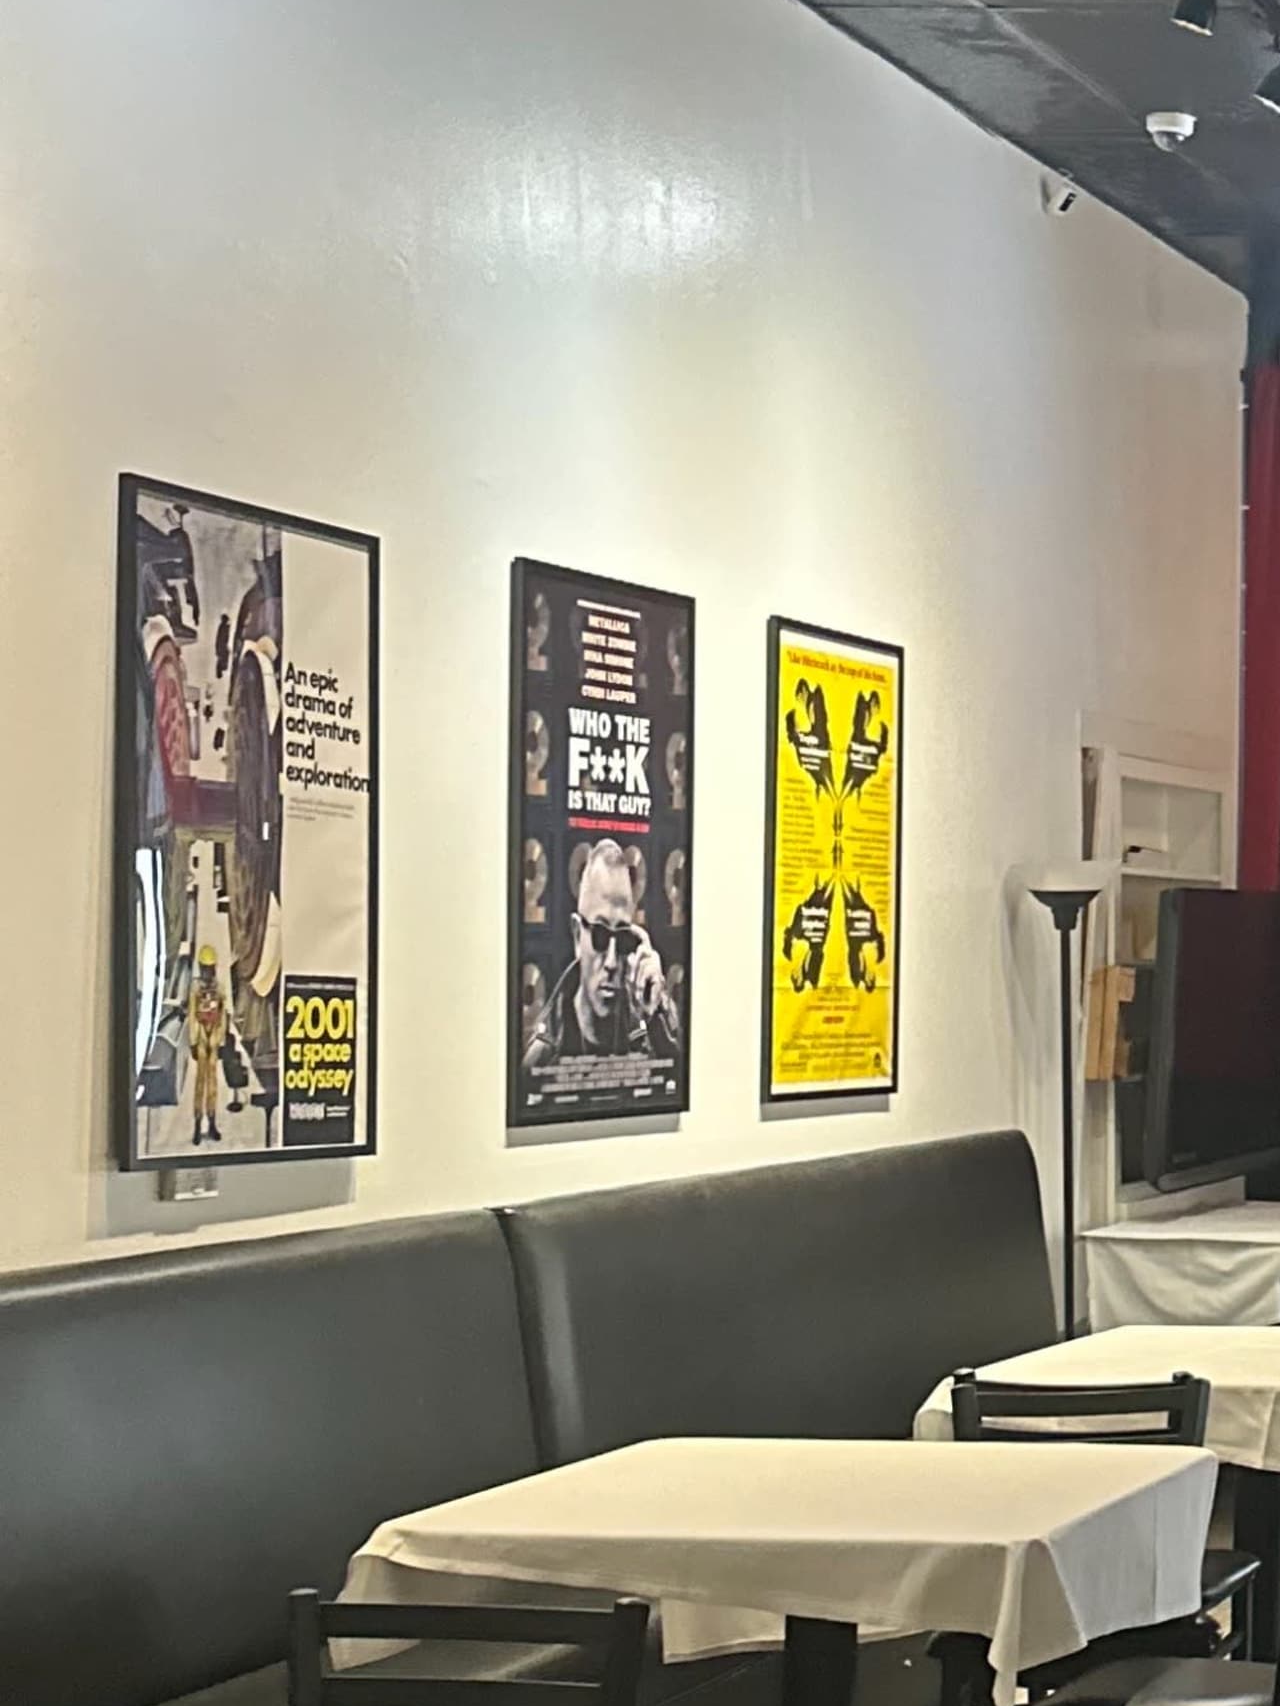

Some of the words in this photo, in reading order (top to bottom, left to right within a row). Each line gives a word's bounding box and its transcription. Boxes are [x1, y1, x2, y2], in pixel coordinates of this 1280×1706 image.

[284, 661, 307, 686] An
[310, 668, 339, 696] epic
[284, 684, 336, 716] drama
[339, 696, 353, 719] of
[285, 711, 361, 745] adventure
[568, 707, 612, 739] WHO
[614, 714, 650, 745] THE
[285, 738, 315, 761] and
[285, 762, 369, 794] exploration
[568, 789, 583, 810] IS
[584, 791, 617, 813] THAT
[618, 795, 651, 817] GUY?
[286, 996, 354, 1040] 2001
[289, 1044, 301, 1063] a
[303, 1044, 351, 1069] space
[286, 1060, 353, 1097] odyssey
